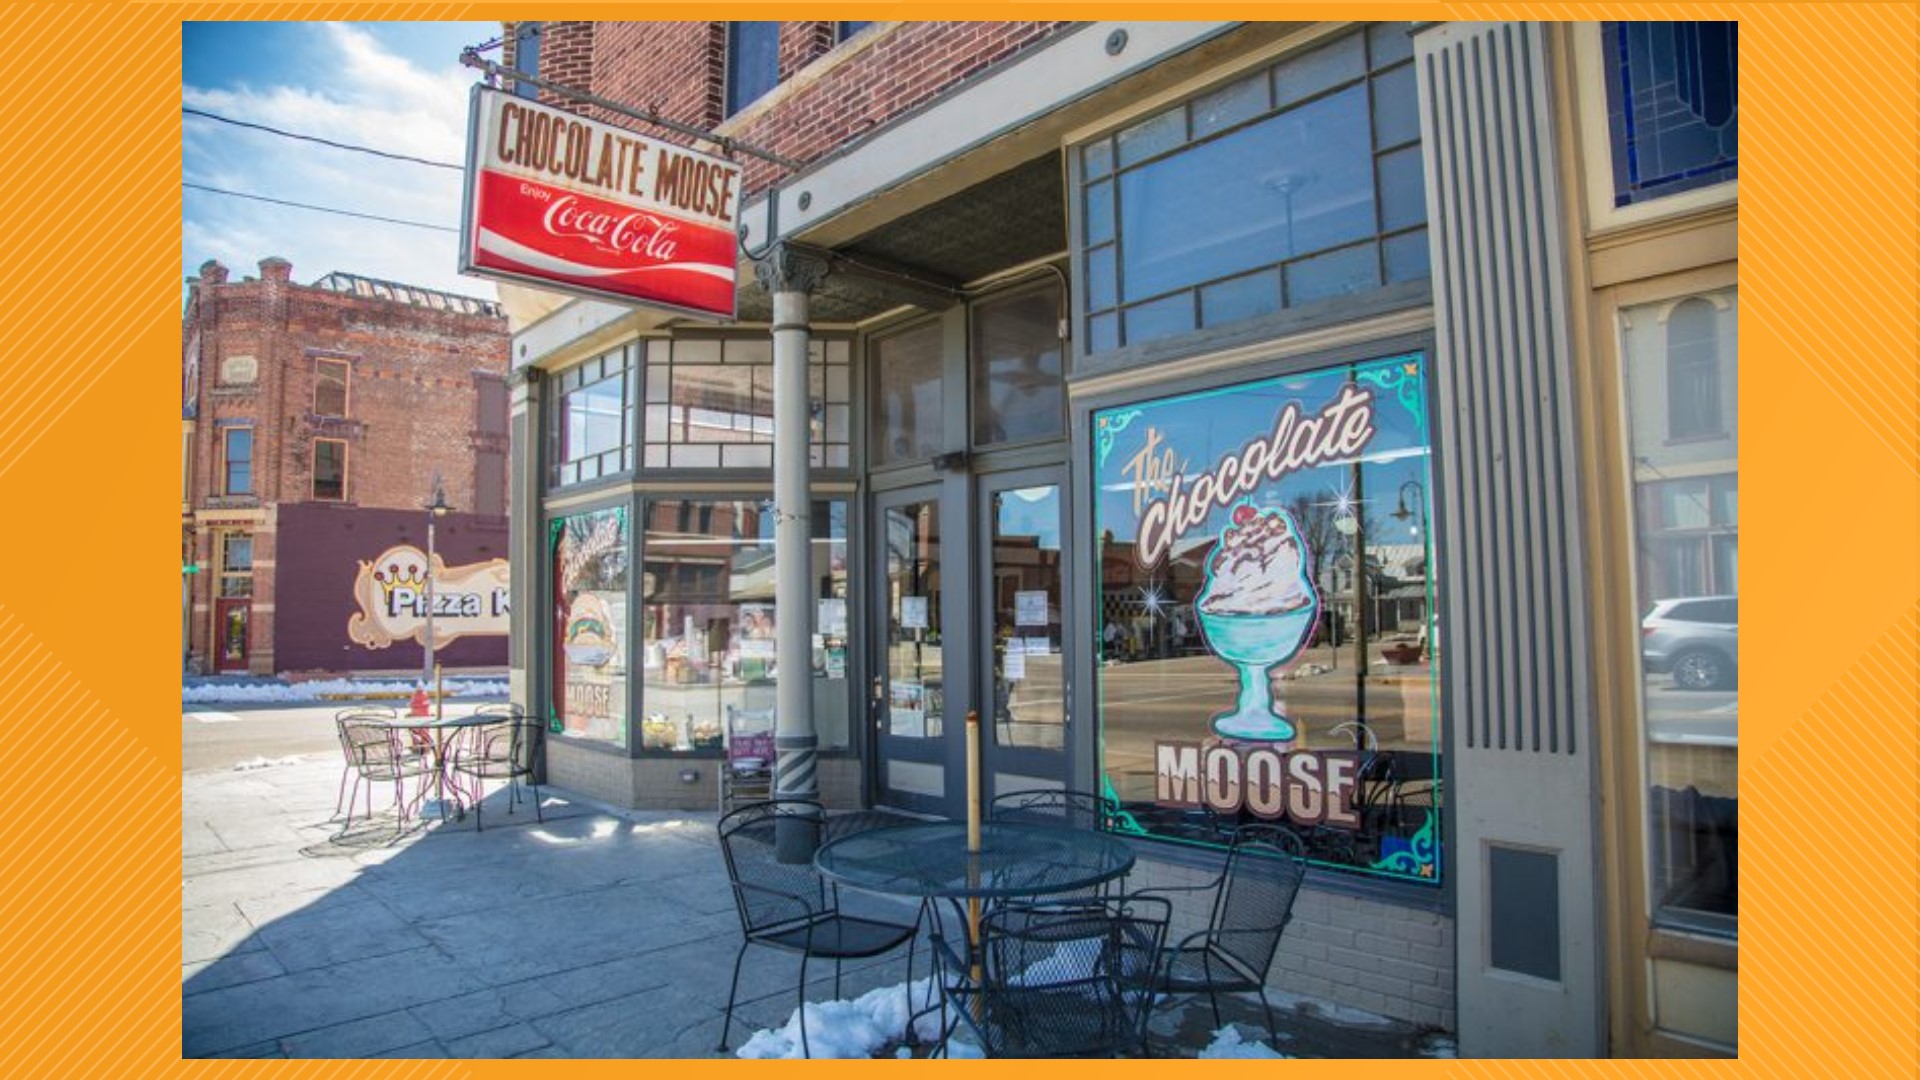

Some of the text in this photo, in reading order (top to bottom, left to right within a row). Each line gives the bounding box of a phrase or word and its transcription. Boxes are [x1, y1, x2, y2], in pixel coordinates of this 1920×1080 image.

[498, 101, 738, 222] CHOCOLATE MOOSE
[520, 184, 552, 203] Enjoy
[543, 195, 680, 261] Coca-Cola
[1121, 427, 1188, 518] The
[388, 587, 482, 617] Pizza
[565, 682, 610, 719] MOOSE
[1156, 743, 1359, 826] MOOSE
